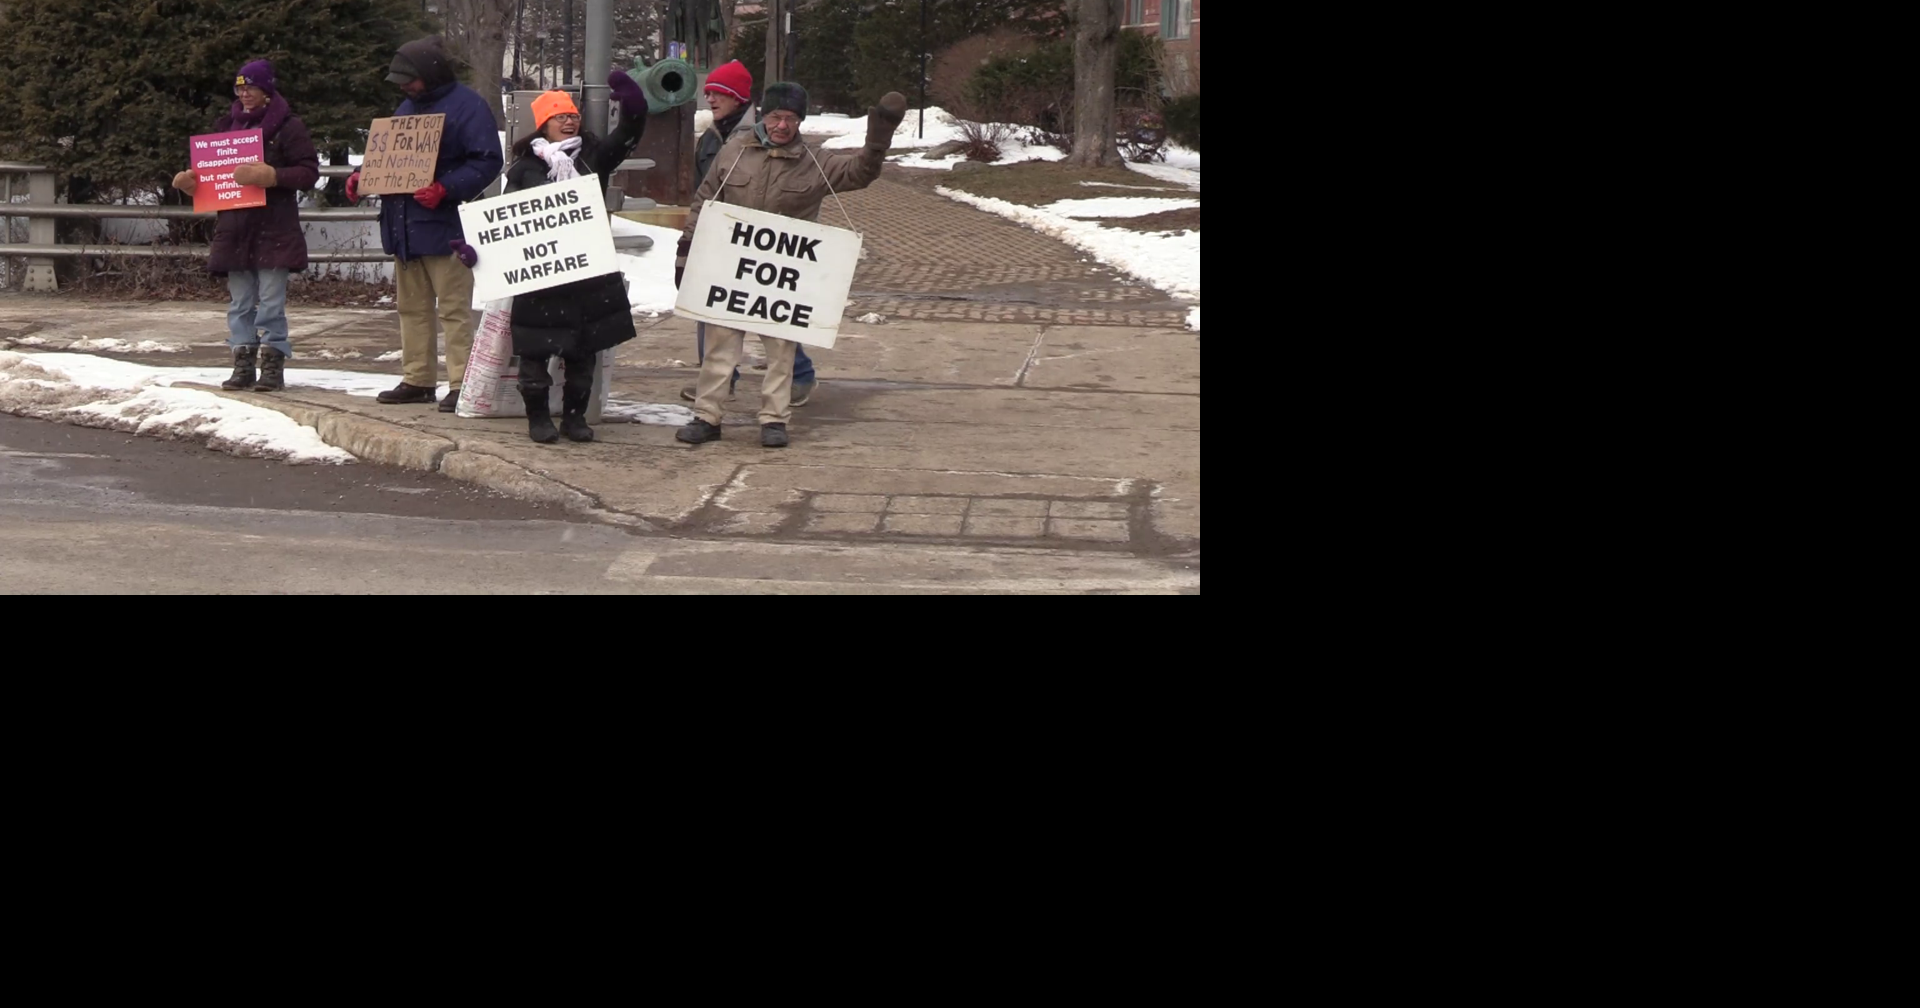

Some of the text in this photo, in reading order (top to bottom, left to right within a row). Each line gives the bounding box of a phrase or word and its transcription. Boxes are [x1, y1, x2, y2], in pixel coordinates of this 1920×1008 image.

[391, 115, 443, 130] THEY GOT
[195, 135, 258, 149] We must accept
[393, 132, 413, 151] FOR
[415, 130, 440, 153] WAR
[197, 154, 258, 168] disappointment
[217, 148, 238, 156] finite
[365, 154, 432, 173] and Nothing
[200, 174, 214, 182] but
[362, 172, 429, 189] for the Poor
[218, 191, 242, 200] HOPE
[483, 190, 579, 223] VETERANS
[478, 206, 593, 245] HEALTHCARE
[522, 240, 558, 261] NOT
[730, 222, 822, 262] HONK
[503, 253, 589, 285] WARFARE
[735, 257, 800, 292] FOR
[706, 285, 813, 328] PEACE
